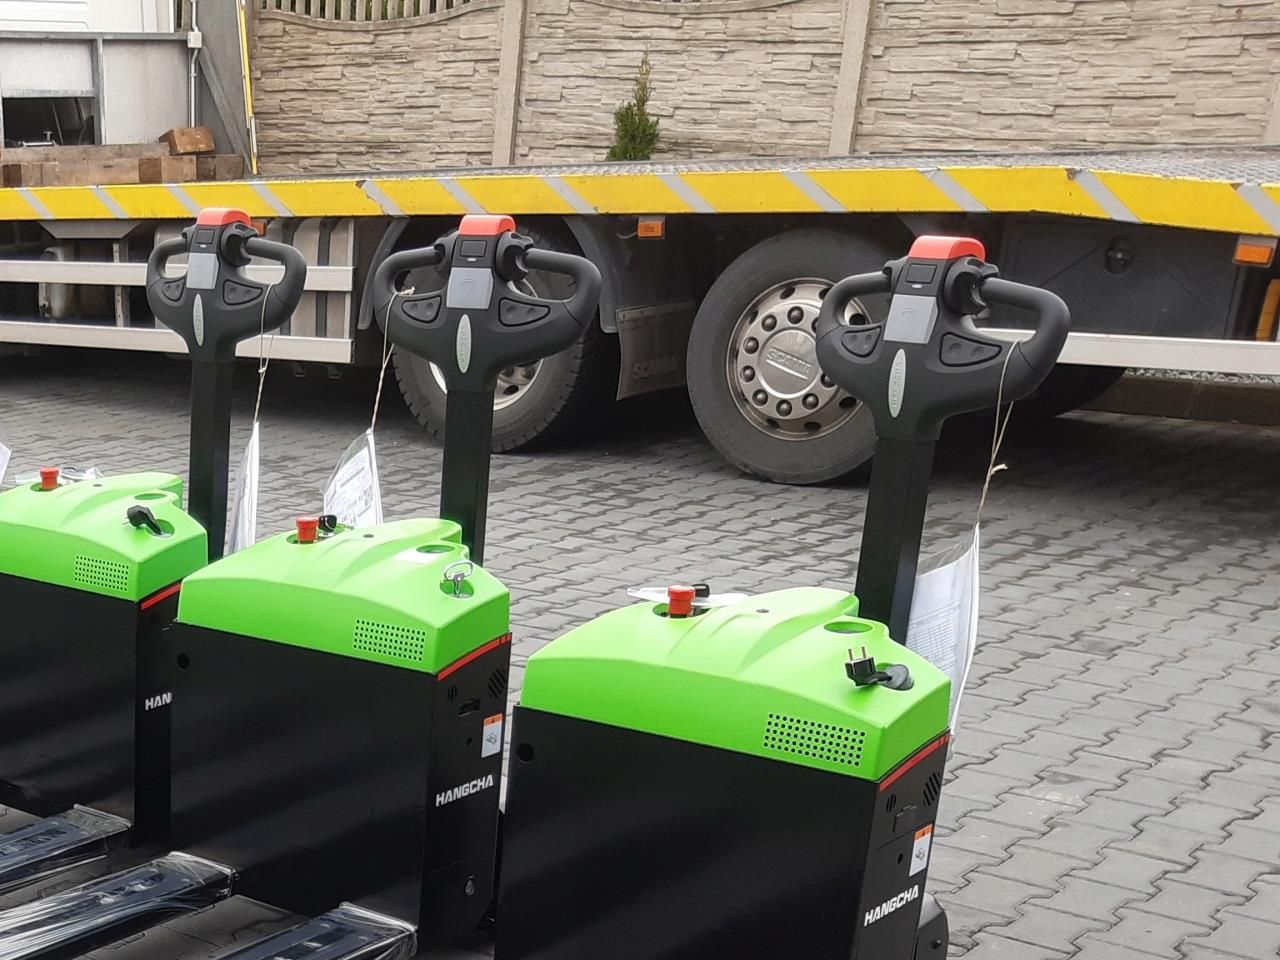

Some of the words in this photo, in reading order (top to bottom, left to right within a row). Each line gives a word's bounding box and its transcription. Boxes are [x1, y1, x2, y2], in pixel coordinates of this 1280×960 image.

[145, 692, 172, 711] HAN
[435, 774, 494, 807] HANGCHA
[863, 884, 919, 927] HANGCHA
